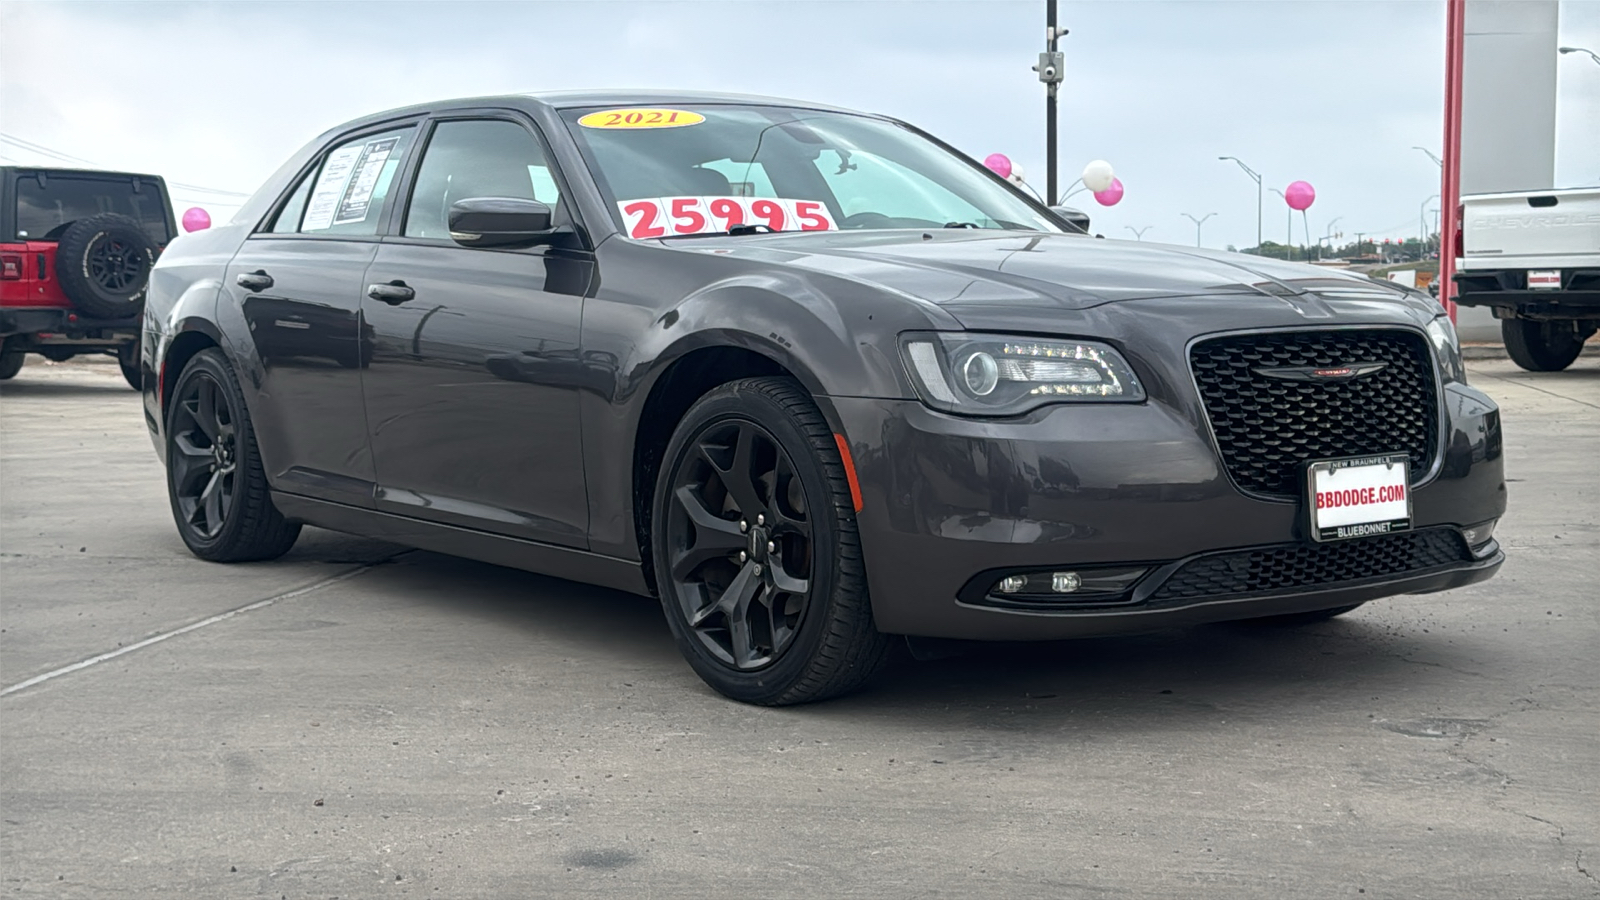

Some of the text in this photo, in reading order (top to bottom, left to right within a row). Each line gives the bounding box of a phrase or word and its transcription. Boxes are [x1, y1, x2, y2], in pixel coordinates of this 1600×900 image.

[604, 112, 679, 126] 2021
[624, 198, 830, 239] 25995
[1316, 485, 1404, 509] BBDODGE.COM
[1337, 522, 1391, 537] BLUEBONNET
